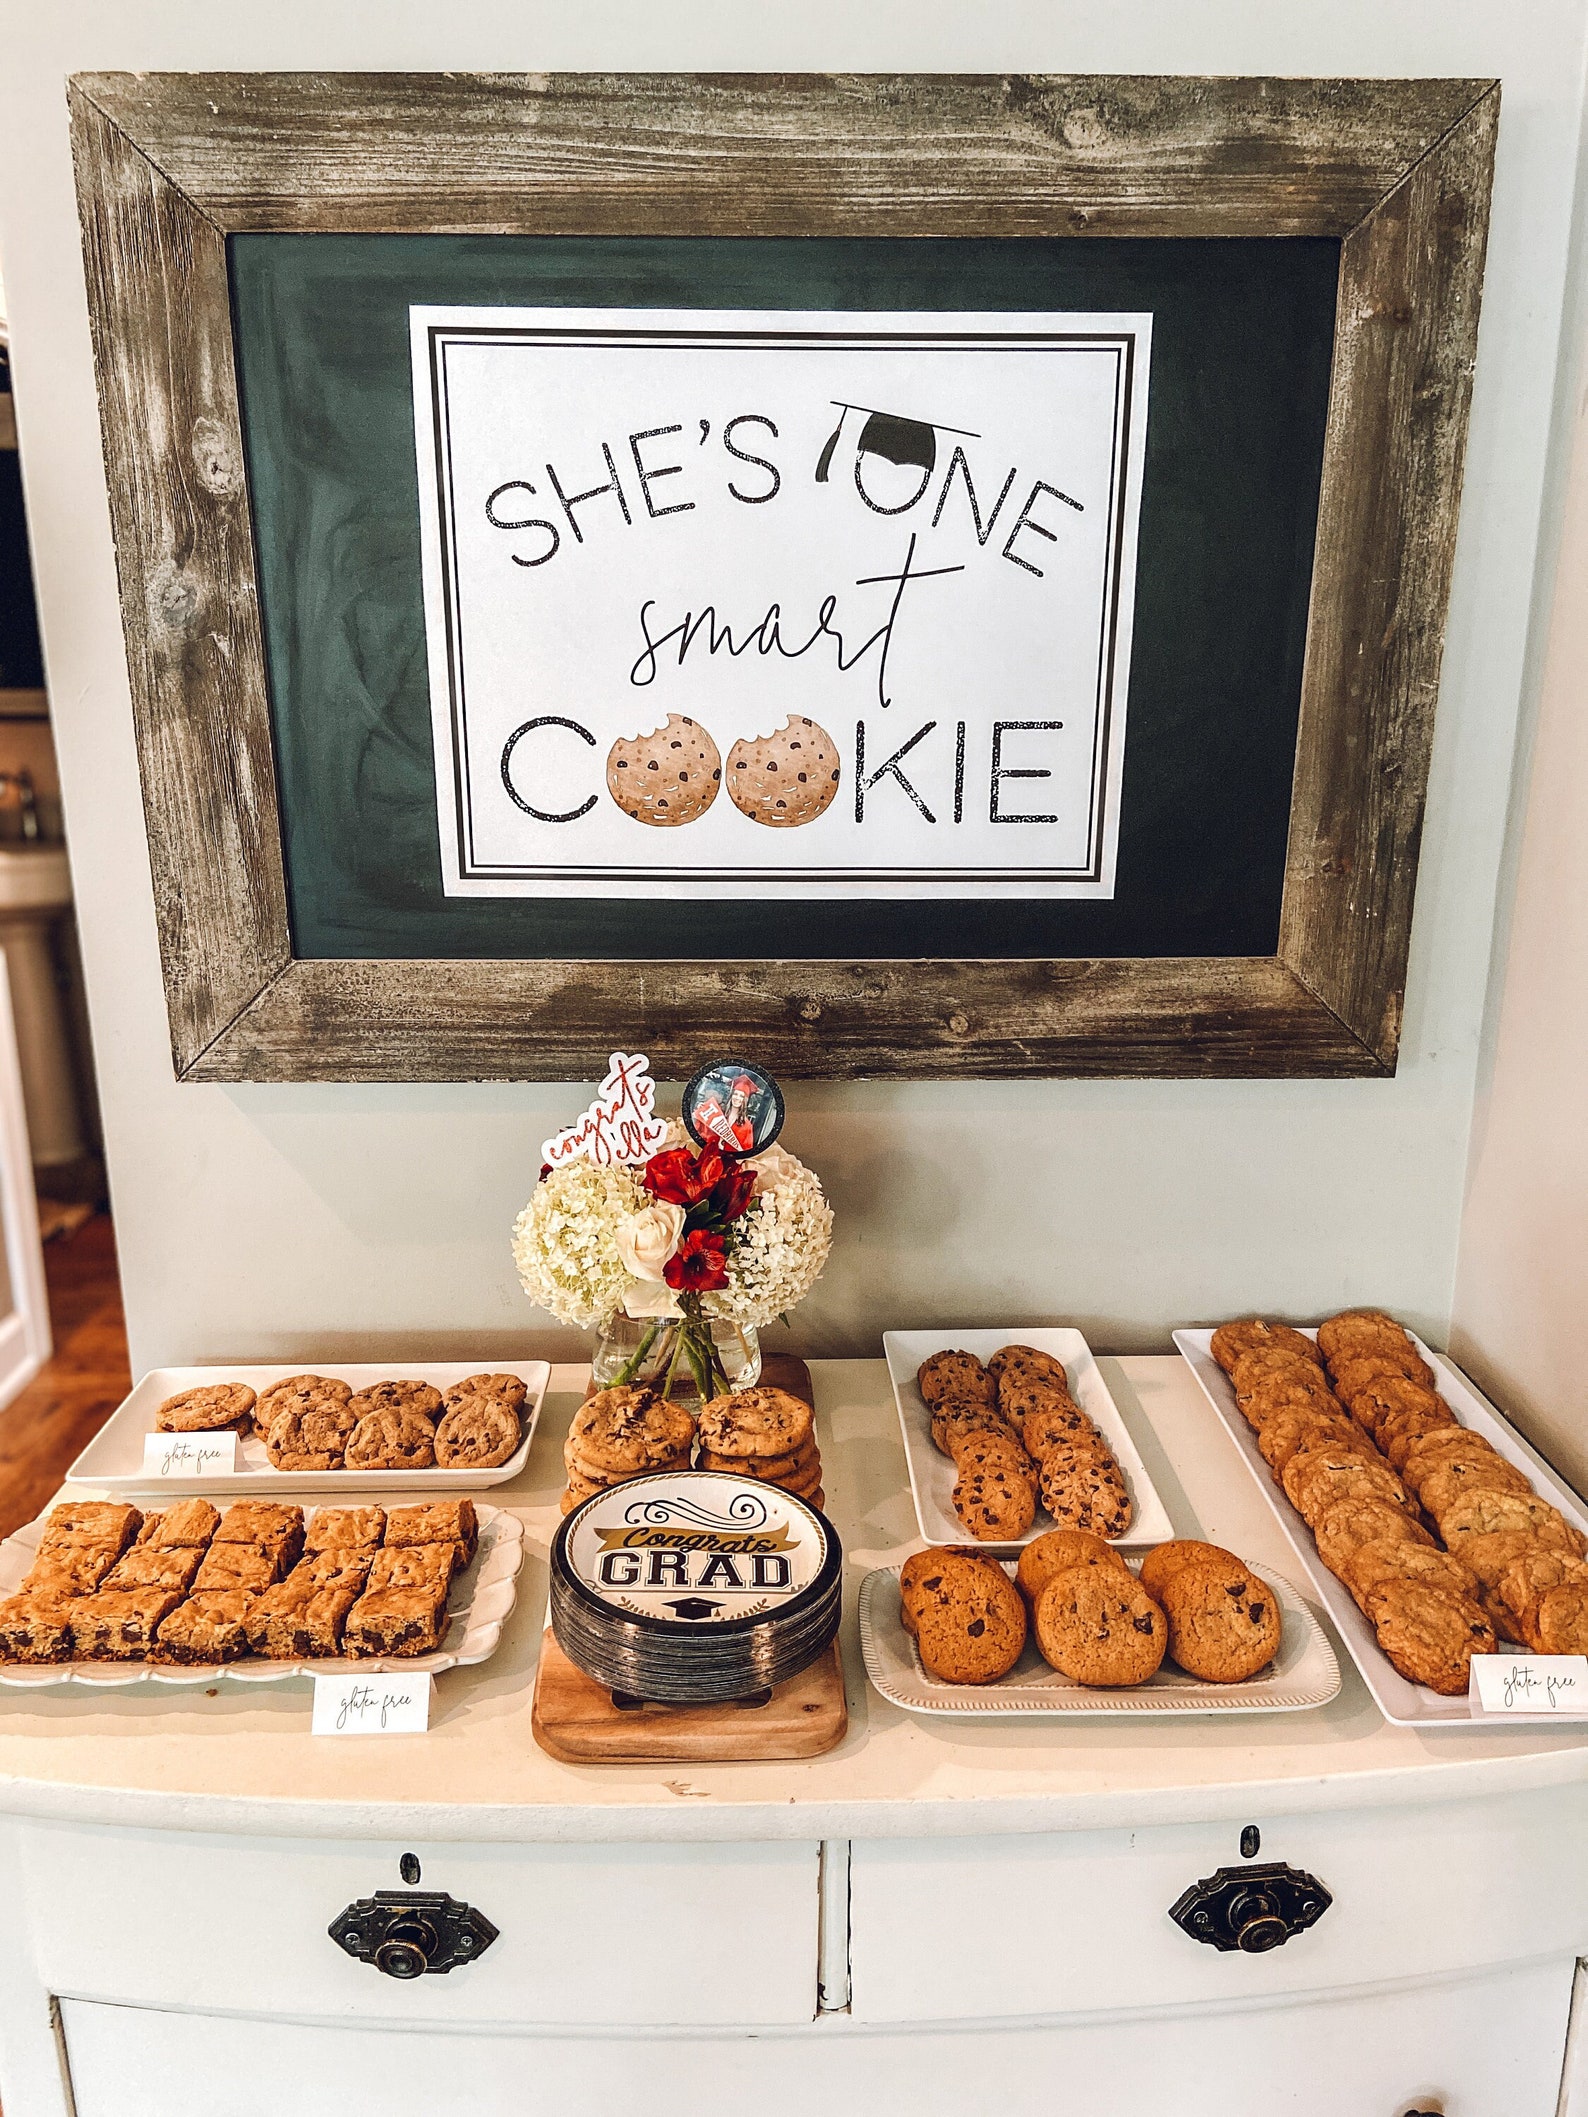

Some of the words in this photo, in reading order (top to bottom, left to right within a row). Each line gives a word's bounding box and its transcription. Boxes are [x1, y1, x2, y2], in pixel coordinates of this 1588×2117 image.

[485, 414, 781, 567] SHE'S
[853, 410, 1085, 579] ONE
[629, 532, 965, 709] smart
[500, 713, 1065, 828] COOKIE
[549, 1059, 650, 1168] congrats
[196, 1448, 221, 1474] free
[622, 1527, 777, 1554] Congrats
[598, 1549, 794, 1591] GRAD
[336, 1686, 379, 1730] gluten
[381, 1694, 412, 1729] free
[1503, 1666, 1542, 1708] gluten
[1547, 1675, 1576, 1708] free
